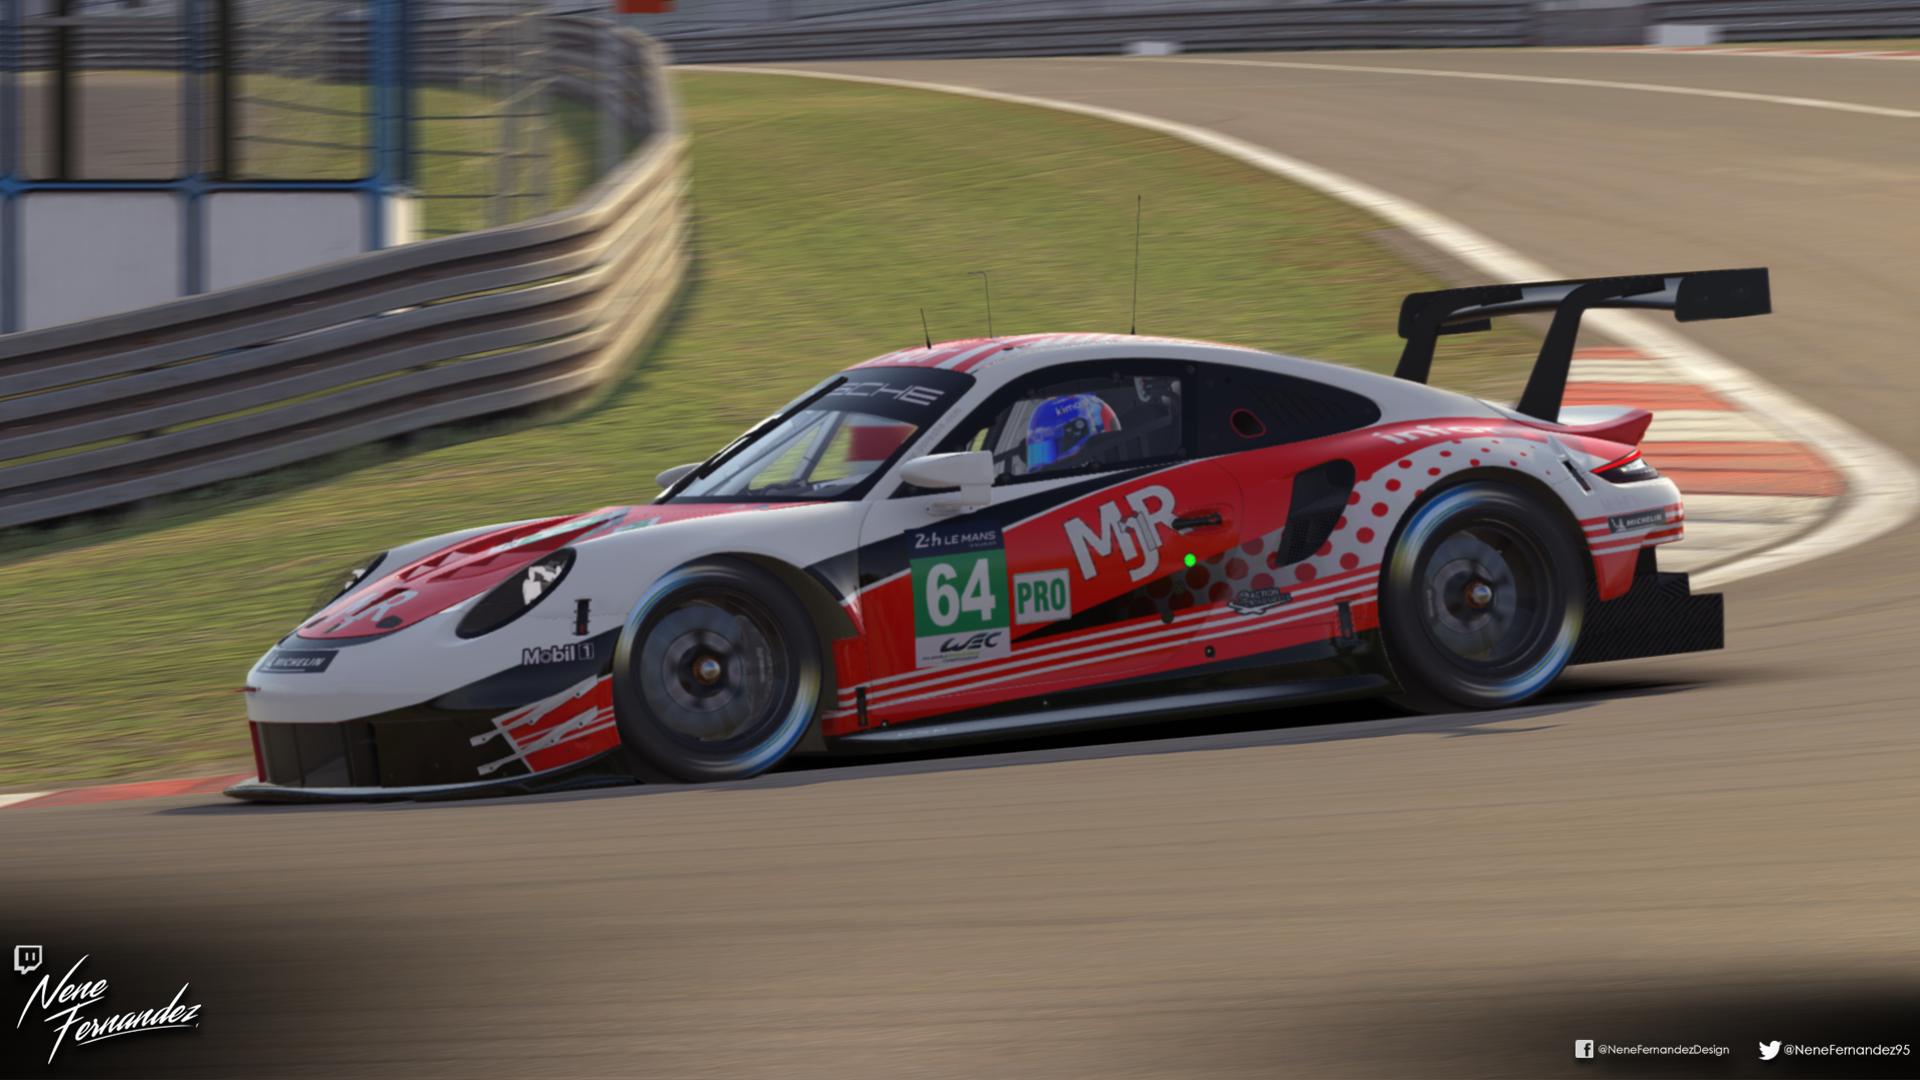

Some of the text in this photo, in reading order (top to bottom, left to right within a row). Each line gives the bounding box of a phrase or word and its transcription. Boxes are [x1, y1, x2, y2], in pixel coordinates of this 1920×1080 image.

[944, 534, 960, 545] LE
[960, 530, 997, 543] MANS
[926, 558, 996, 627] 64
[1017, 577, 1067, 615] PRO
[940, 631, 1002, 653] WEC
[522, 644, 577, 666] Mobil
